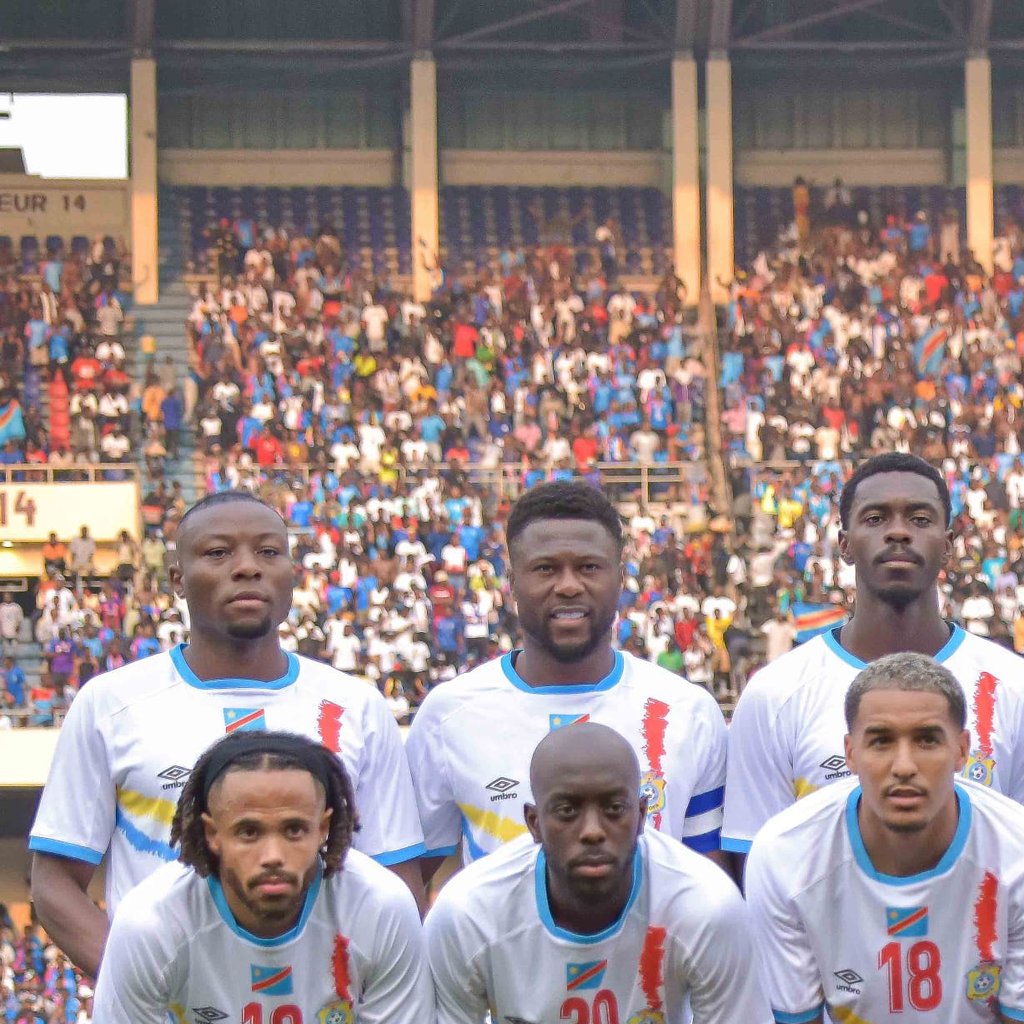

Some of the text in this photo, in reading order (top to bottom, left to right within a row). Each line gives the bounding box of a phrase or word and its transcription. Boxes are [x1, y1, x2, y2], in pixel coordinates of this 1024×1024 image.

[63, 194, 86, 212] 14
[0, 490, 36, 526] 14
[162, 781, 187, 790] umbr
[490, 792, 518, 801] umbro
[878, 941, 942, 1014] 18
[836, 984, 861, 995] umbro
